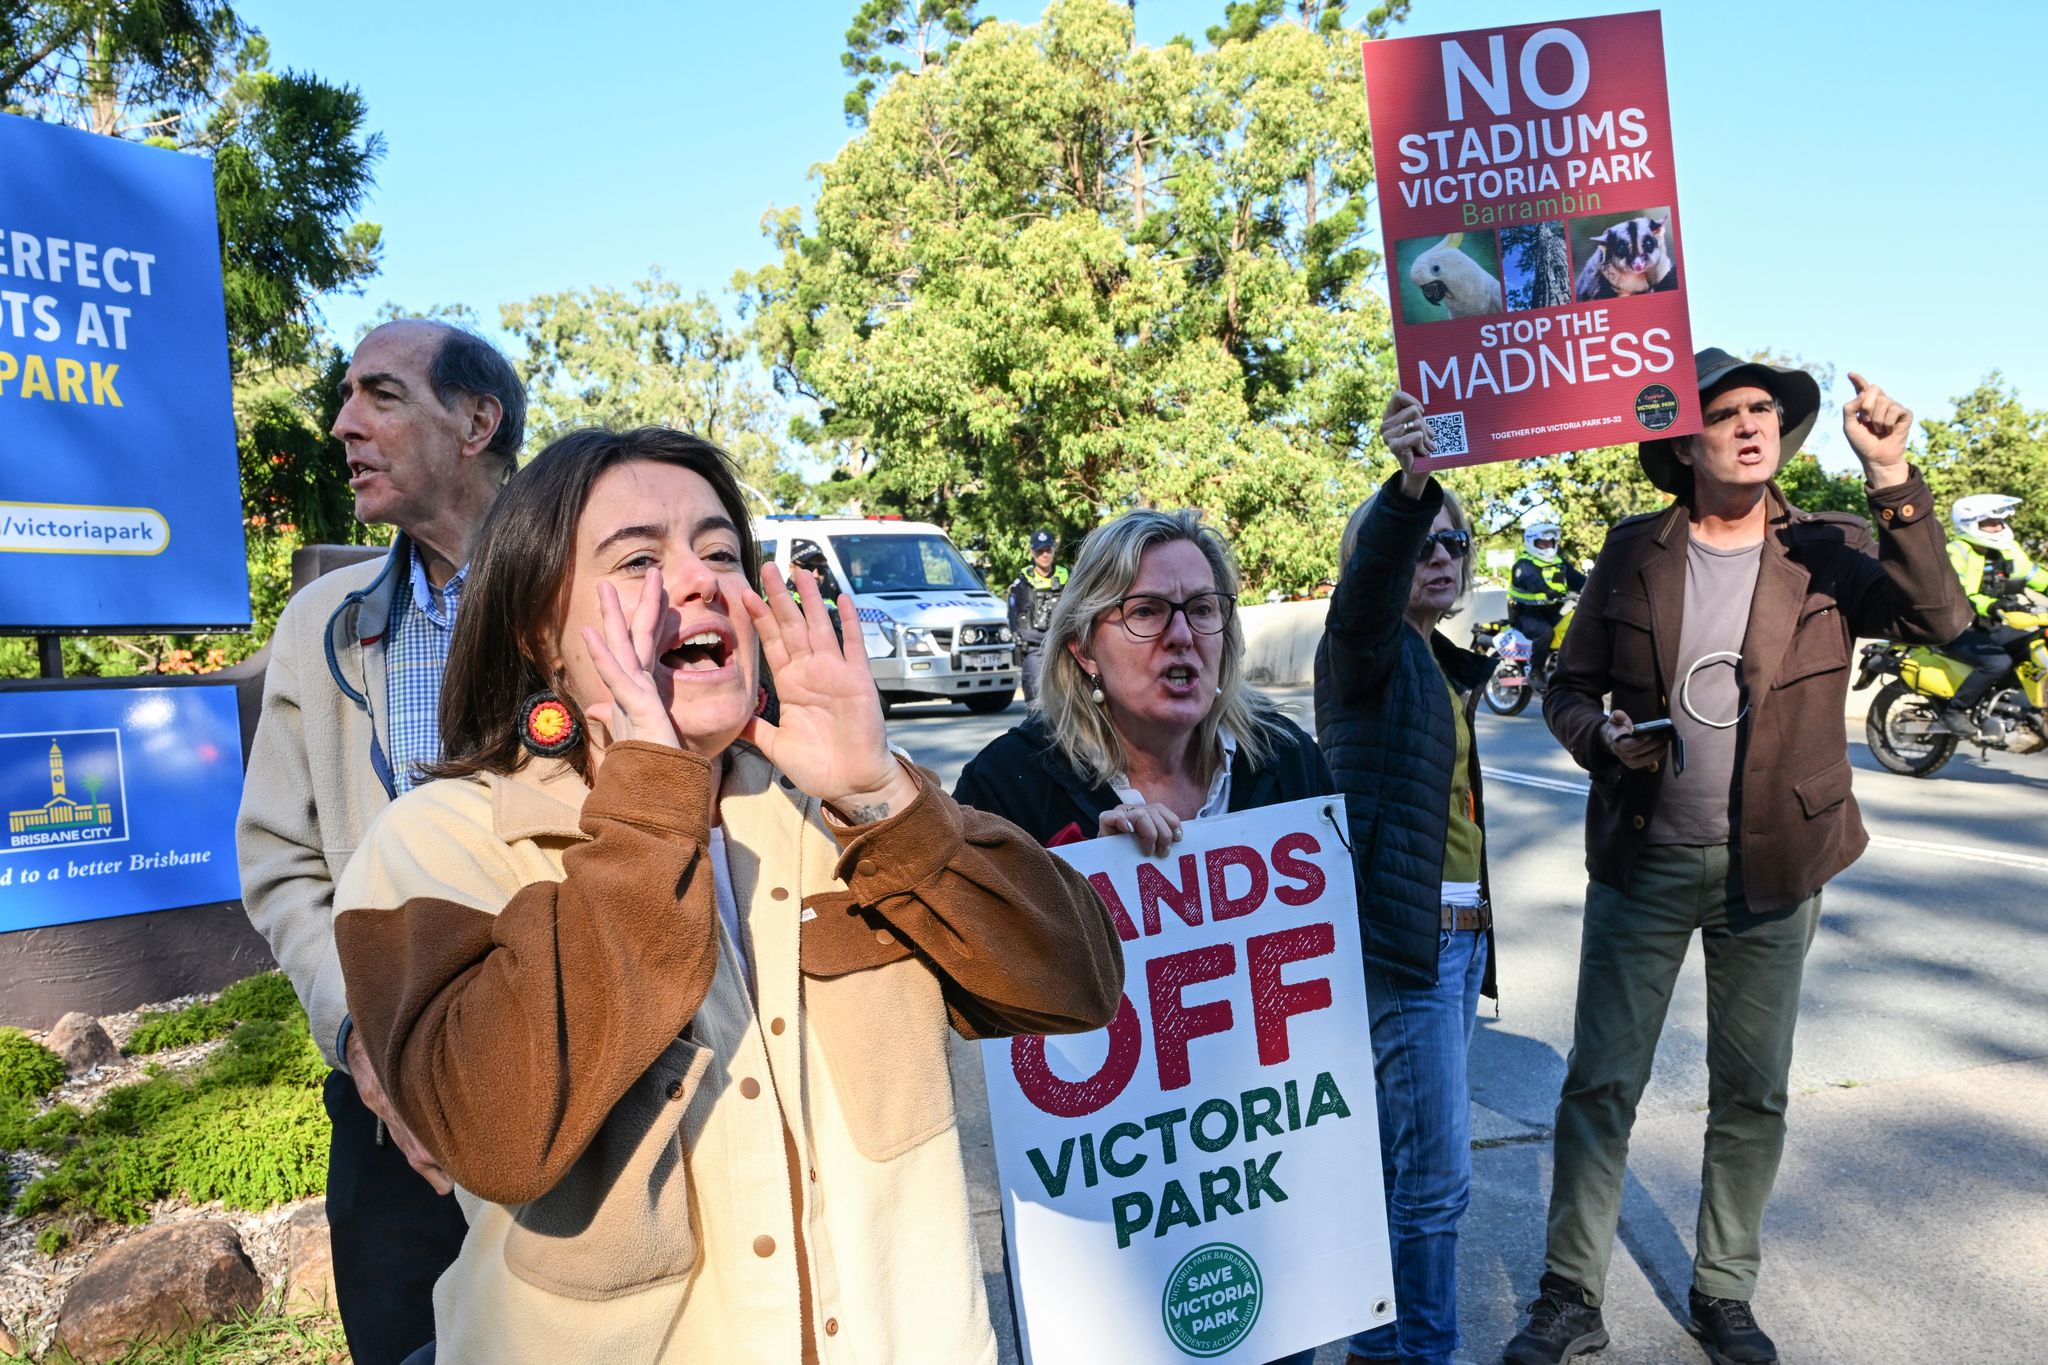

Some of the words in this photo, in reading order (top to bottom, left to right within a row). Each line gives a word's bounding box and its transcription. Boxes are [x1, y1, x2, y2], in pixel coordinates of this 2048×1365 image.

[1441, 27, 1591, 122] NO
[1399, 107, 1649, 175] STADIUMS
[1398, 163, 1561, 208] VICTORIA
[1568, 151, 1655, 189] PARK
[1463, 190, 1602, 226] Barrambin
[0, 289, 61, 342] TS
[75, 301, 131, 350] AT
[1480, 316, 1552, 348] STOP
[1556, 309, 1610, 337] THE
[0, 351, 124, 407] PARK
[1417, 328, 1675, 405] MADNESS
[1490, 429, 1530, 441] TOGETHER
[1530, 426, 1547, 435] FOR
[1547, 420, 1582, 433] VICTORIA
[1581, 418, 1602, 428] PARK
[1602, 415, 1622, 425] 25-32
[0, 516, 153, 542] /victoriapark
[11, 830, 80, 847] BRISBANE
[81, 827, 112, 839] CITY
[20, 869, 40, 884] to
[47, 867, 60, 881] a
[67, 861, 123, 878] better
[129, 850, 212, 872] Brisbane
[1010, 922, 1336, 1118] OFF
[1026, 1071, 1351, 1198] VICTORIA
[1111, 1151, 1288, 1250] PARK
[1169, 1281, 1256, 1320] VICTORIA
[1171, 1265, 1193, 1302] VICTORIA
[1192, 1252, 1212, 1266] PARK
[1214, 1251, 1252, 1279] BARRAMBIN
[1187, 1265, 1233, 1293] SAVE
[1174, 1322, 1211, 1349] RESIDENTS
[1212, 1327, 1240, 1348] ACTION
[1239, 1299, 1254, 1328] GROUP
[1191, 1306, 1240, 1336] PARK
